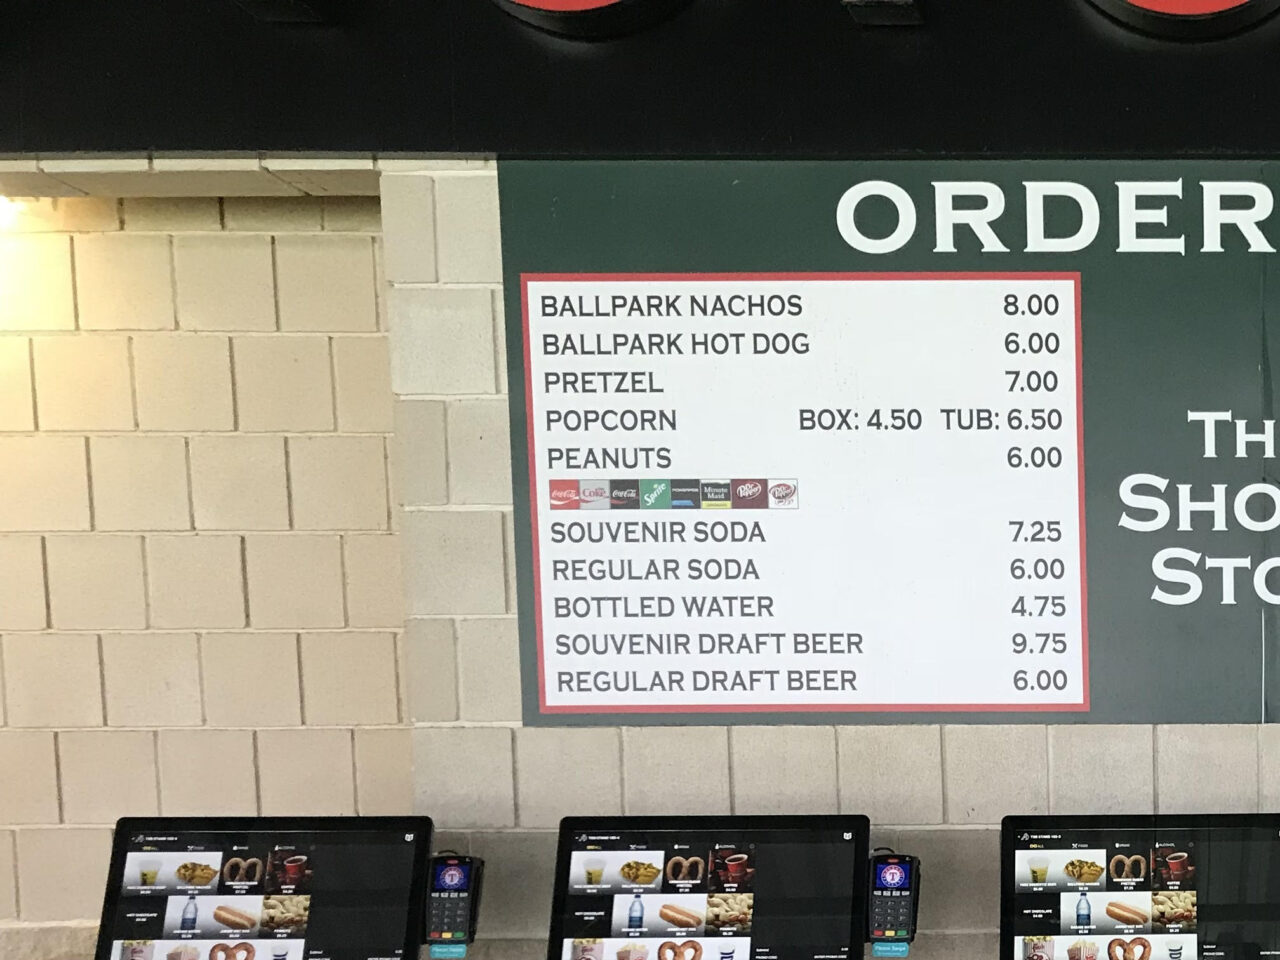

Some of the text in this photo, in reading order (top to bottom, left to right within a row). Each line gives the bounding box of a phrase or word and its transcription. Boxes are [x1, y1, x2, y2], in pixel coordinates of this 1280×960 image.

[837, 178, 1276, 255] ORDER
[541, 295, 802, 316] BALLPARK NACHOS
[1004, 294, 1059, 315] 8.00
[543, 333, 809, 355] BALLPARK HOT DOG
[1005, 333, 1059, 354] 6.00
[545, 372, 664, 393] PRETZEL
[1005, 371, 1058, 392] 7.00
[547, 410, 676, 431] POPCORN
[800, 409, 922, 430] BOX: 4.50
[940, 409, 1062, 430] TUB: 6.50
[548, 448, 671, 469] PEANUTS
[1008, 447, 1062, 468] 6.00
[644, 483, 667, 506] Sprite
[551, 522, 765, 543] SOUVENIR SODA
[1009, 521, 1061, 542] 7.25
[553, 559, 759, 580] REGULAR SODA
[1011, 559, 1064, 579] 6.00
[555, 597, 773, 617] BOTTLED WATER
[1012, 596, 1065, 616] 4.75
[556, 634, 862, 655] SOUVENIR DRAFT BEER
[1013, 633, 1066, 653] 9.75
[558, 671, 856, 691] REGULAR DRAFT BEER
[1014, 670, 1067, 690] 6.00
